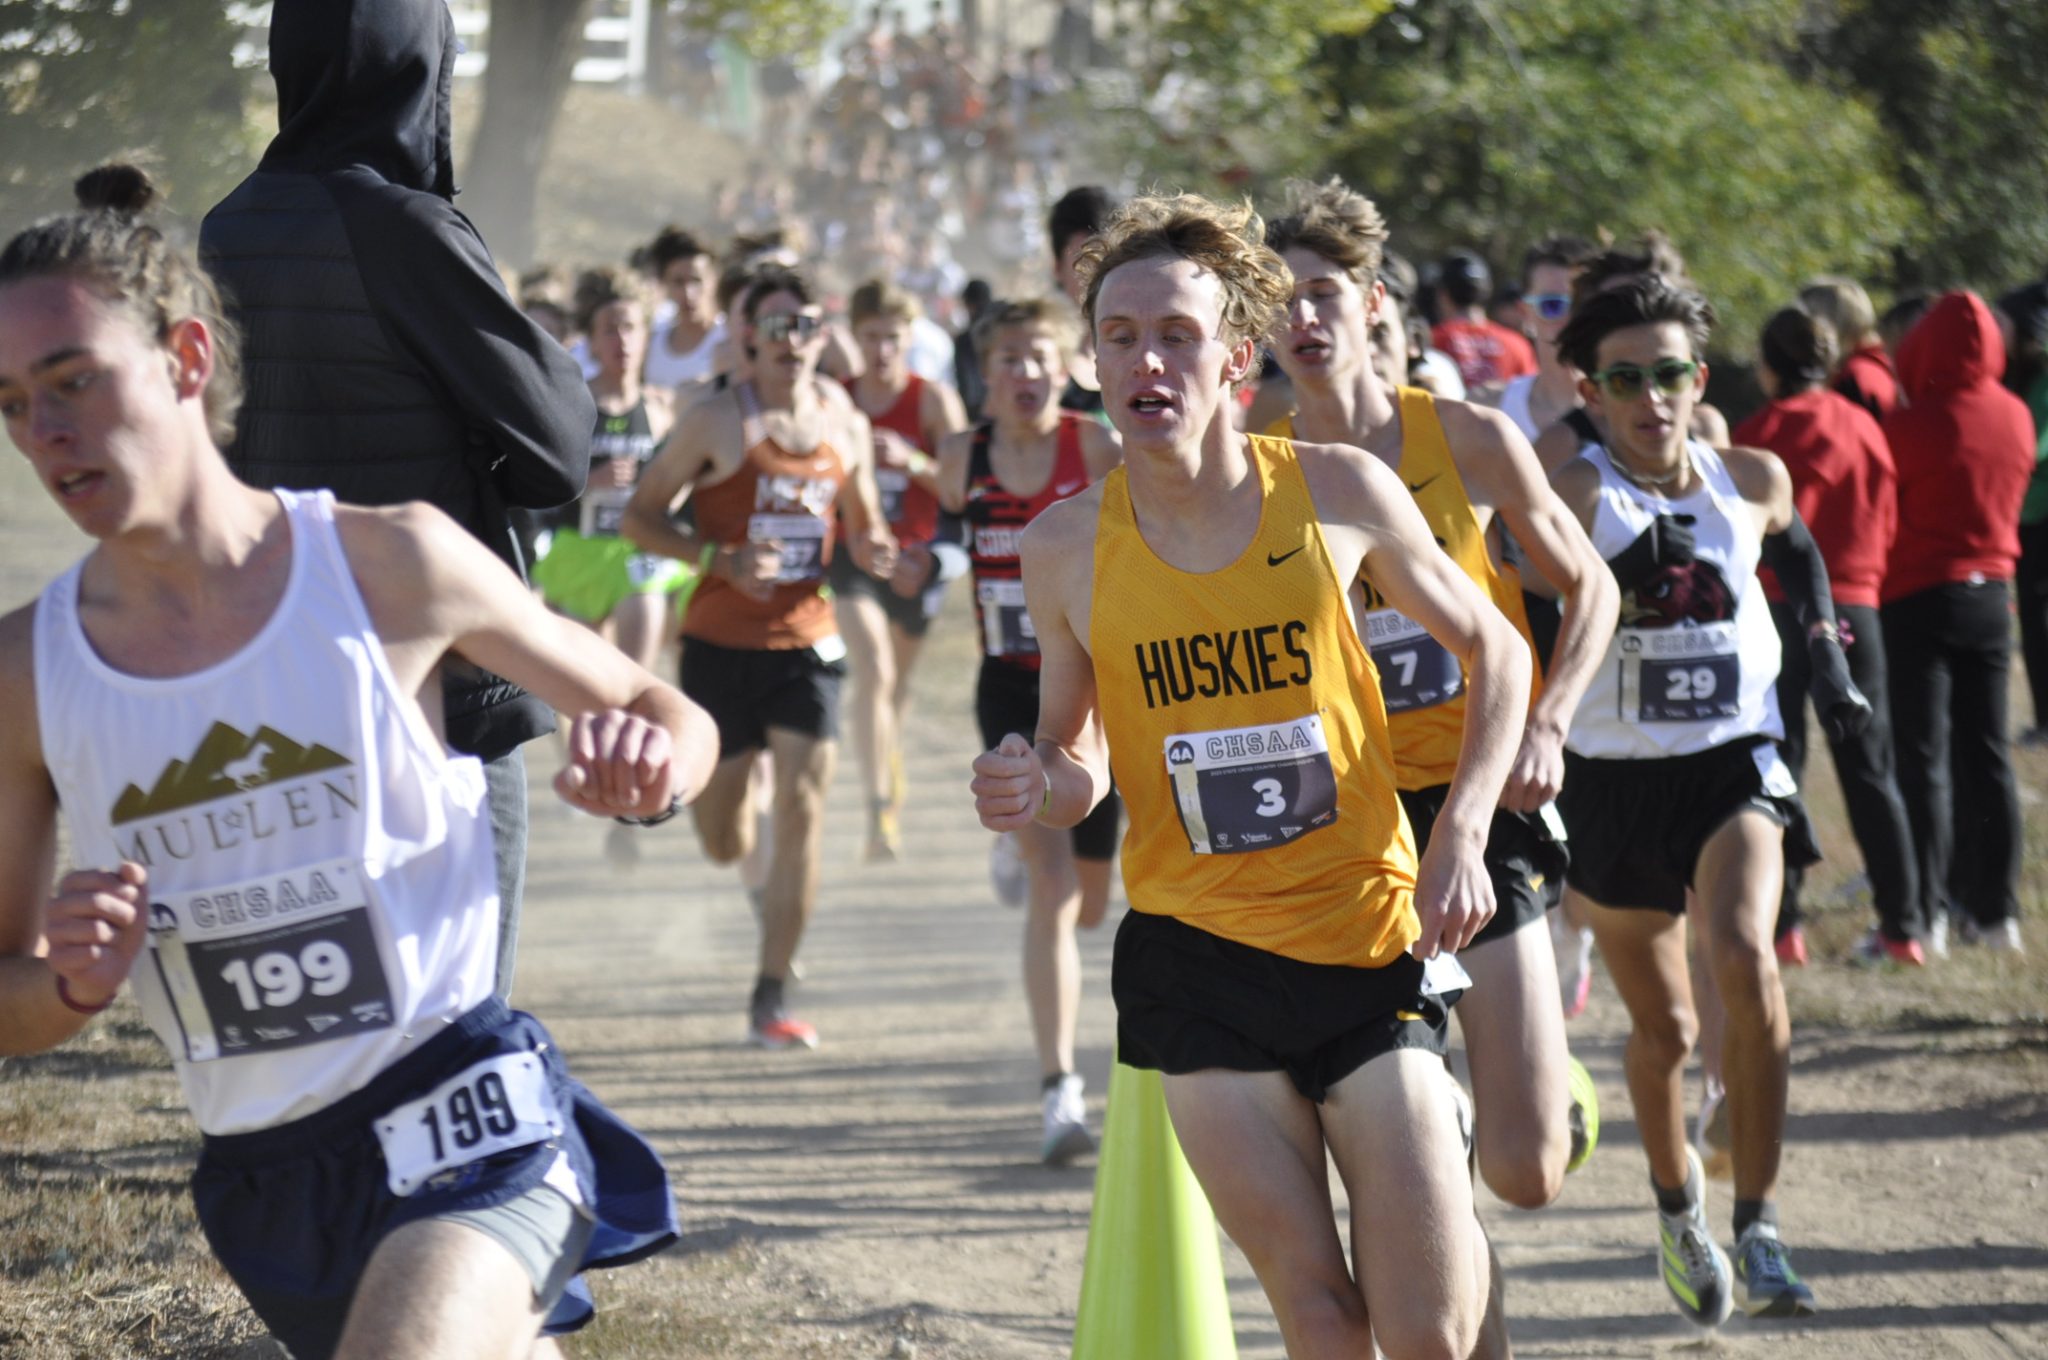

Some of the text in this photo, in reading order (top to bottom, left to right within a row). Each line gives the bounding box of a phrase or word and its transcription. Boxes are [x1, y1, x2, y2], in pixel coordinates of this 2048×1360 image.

[1135, 620, 1313, 709] HUSKIES
[1389, 651, 1418, 687] 7
[1665, 667, 1717, 701] 29
[1170, 747, 1194, 762] 4A
[1206, 725, 1311, 760] CHSAA
[112, 774, 360, 866] MULLEN
[1252, 777, 1287, 817] 3
[190, 871, 339, 929] CHSAA
[220, 940, 352, 1011] 199
[420, 1072, 517, 1163] 199
